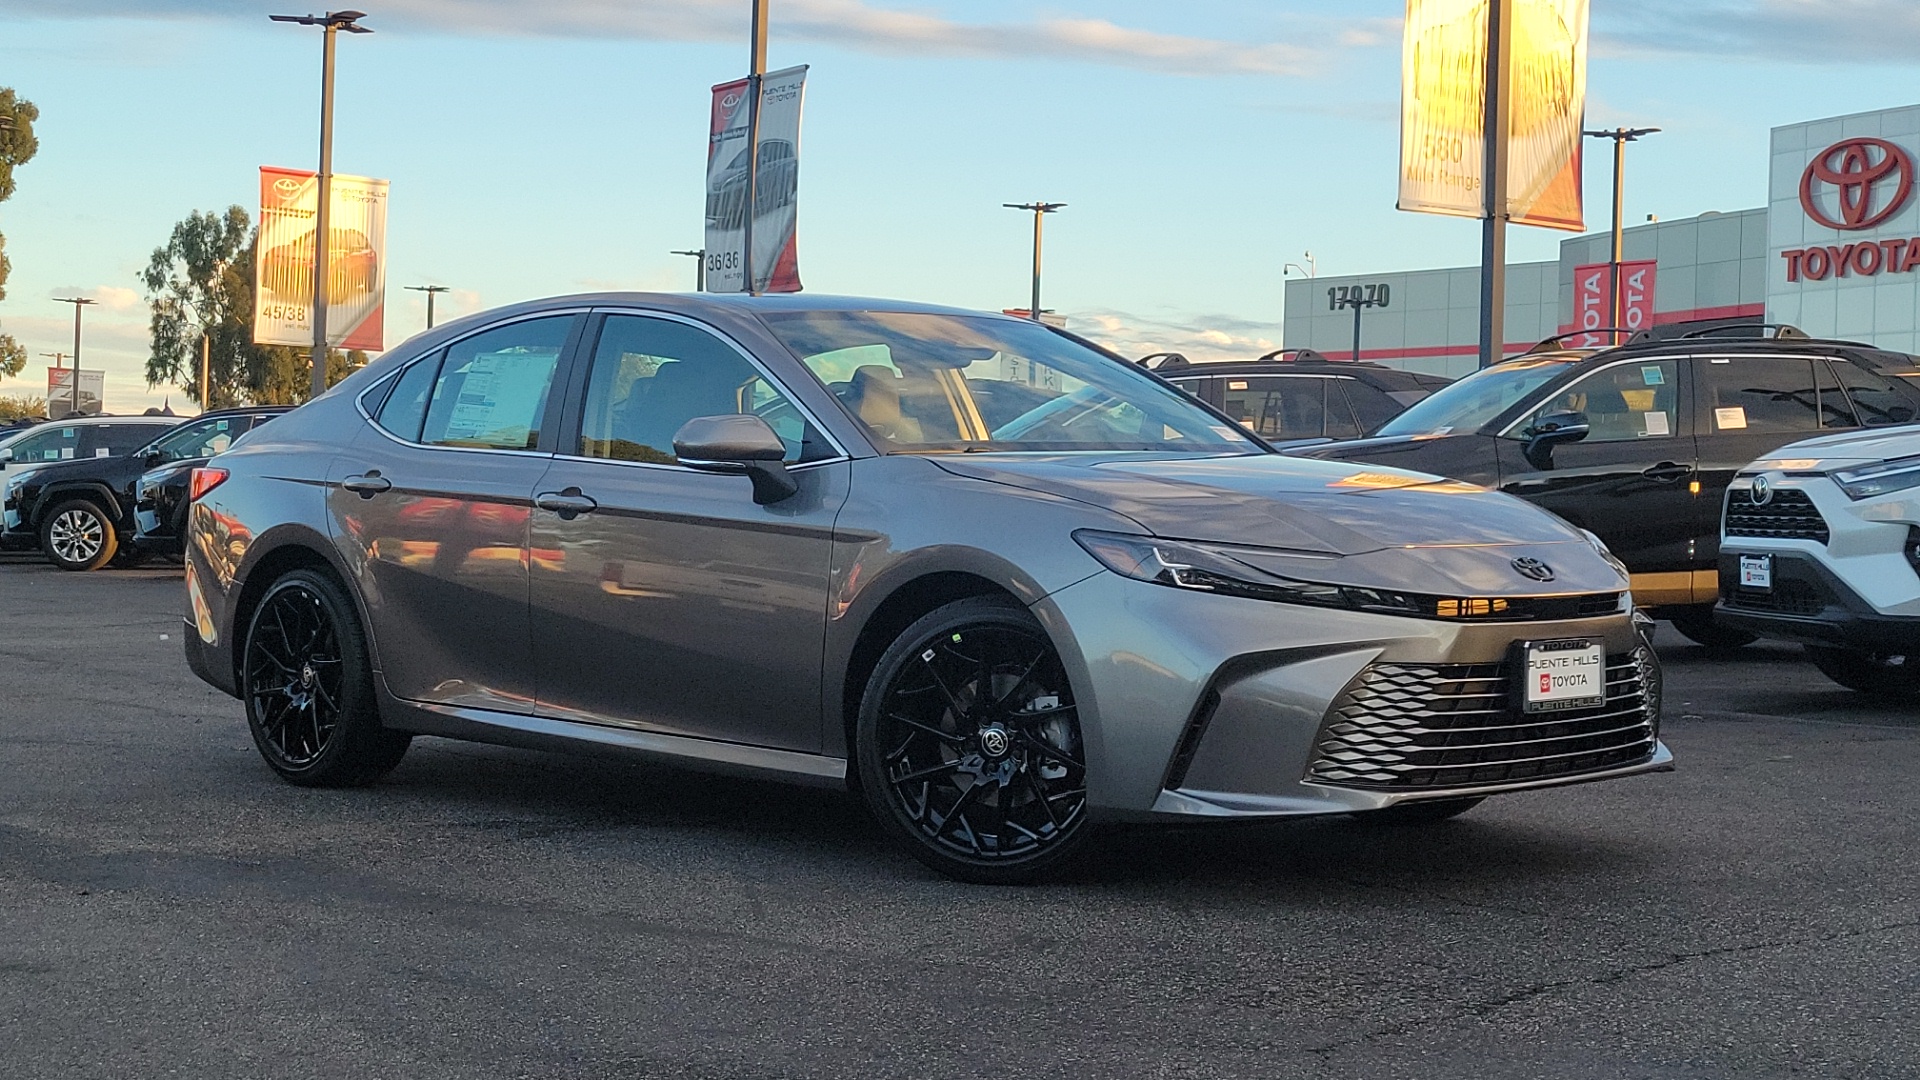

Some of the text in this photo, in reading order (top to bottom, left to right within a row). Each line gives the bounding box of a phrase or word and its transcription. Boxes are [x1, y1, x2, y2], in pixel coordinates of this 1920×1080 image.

[1423, 134, 1463, 163] 580
[1406, 166, 1481, 191] Mile Range
[707, 251, 739, 272] 36/36
[1781, 237, 1920, 283] TOYOTA
[262, 305, 305, 321] 45/38
[1546, 640, 1586, 650] TOYOTA
[1528, 654, 1599, 670] PUENTE HILLS
[1551, 674, 1588, 688] TOYOTA
[1531, 696, 1601, 712] PUENTE HILLS
